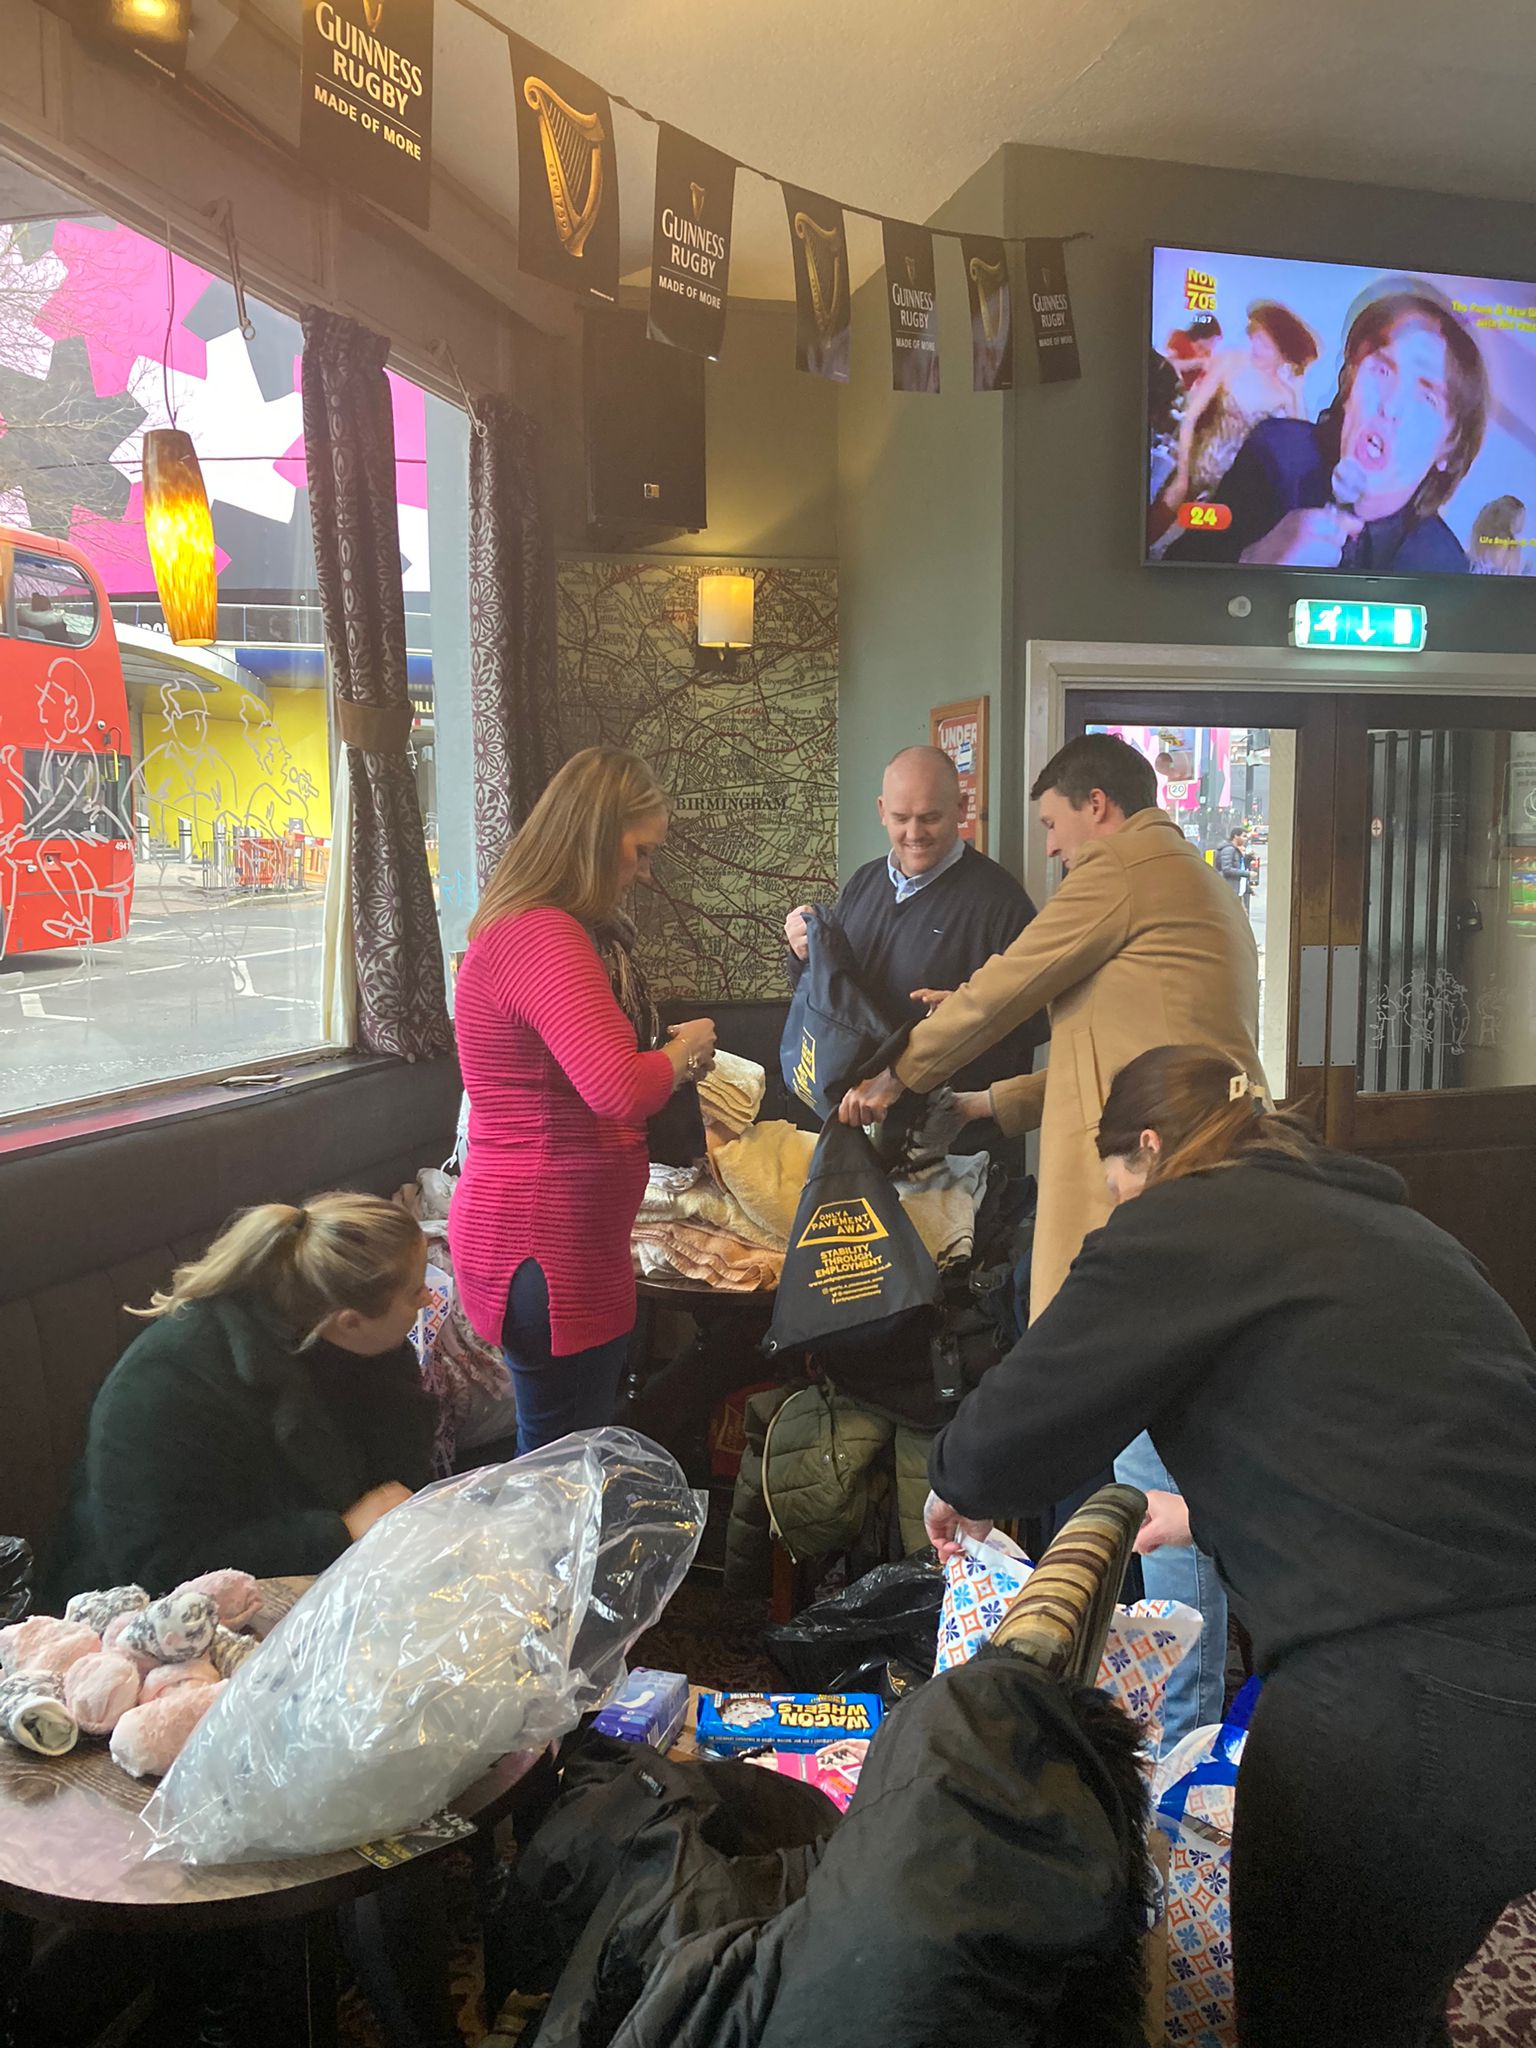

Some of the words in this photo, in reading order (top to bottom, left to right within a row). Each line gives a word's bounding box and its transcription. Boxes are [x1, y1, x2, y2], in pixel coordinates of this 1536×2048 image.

[315, 1, 423, 97] GUINNESS
[333, 49, 409, 116] RUGBY
[314, 84, 358, 123] MADE
[361, 113, 380, 134] OF
[383, 125, 422, 161] MORE
[662, 208, 725, 260] GUINNESS
[671, 243, 716, 279] RUGBY
[658, 275, 685, 295] MADE
[686, 286, 698, 300] OF
[699, 290, 722, 309] MORE
[892, 283, 934, 312] GUINNESS
[1186, 290, 1217, 310] 70s
[1032, 292, 1068, 312] GUINNESS
[900, 309, 929, 329] RUGBY
[1041, 312, 1065, 328] RUGBY
[895, 337, 912, 349] MADE
[912, 339, 920, 350] OF
[1189, 509, 1218, 526] 24
[1171, 785, 1184, 793] 20
[676, 797, 788, 810] BIRMINGHAM
[811, 1213, 869, 1231] PAVEMENT
[819, 1210, 841, 1221] ONLY
[837, 1220, 871, 1235] AWAY
[820, 1243, 870, 1260] STABILITY
[821, 1250, 873, 1267] THROUGH
[815, 1255, 883, 1279] EMPLOYMENT
[777, 1702, 868, 1716] WHEELS
[780, 1711, 871, 1730] WAGON
